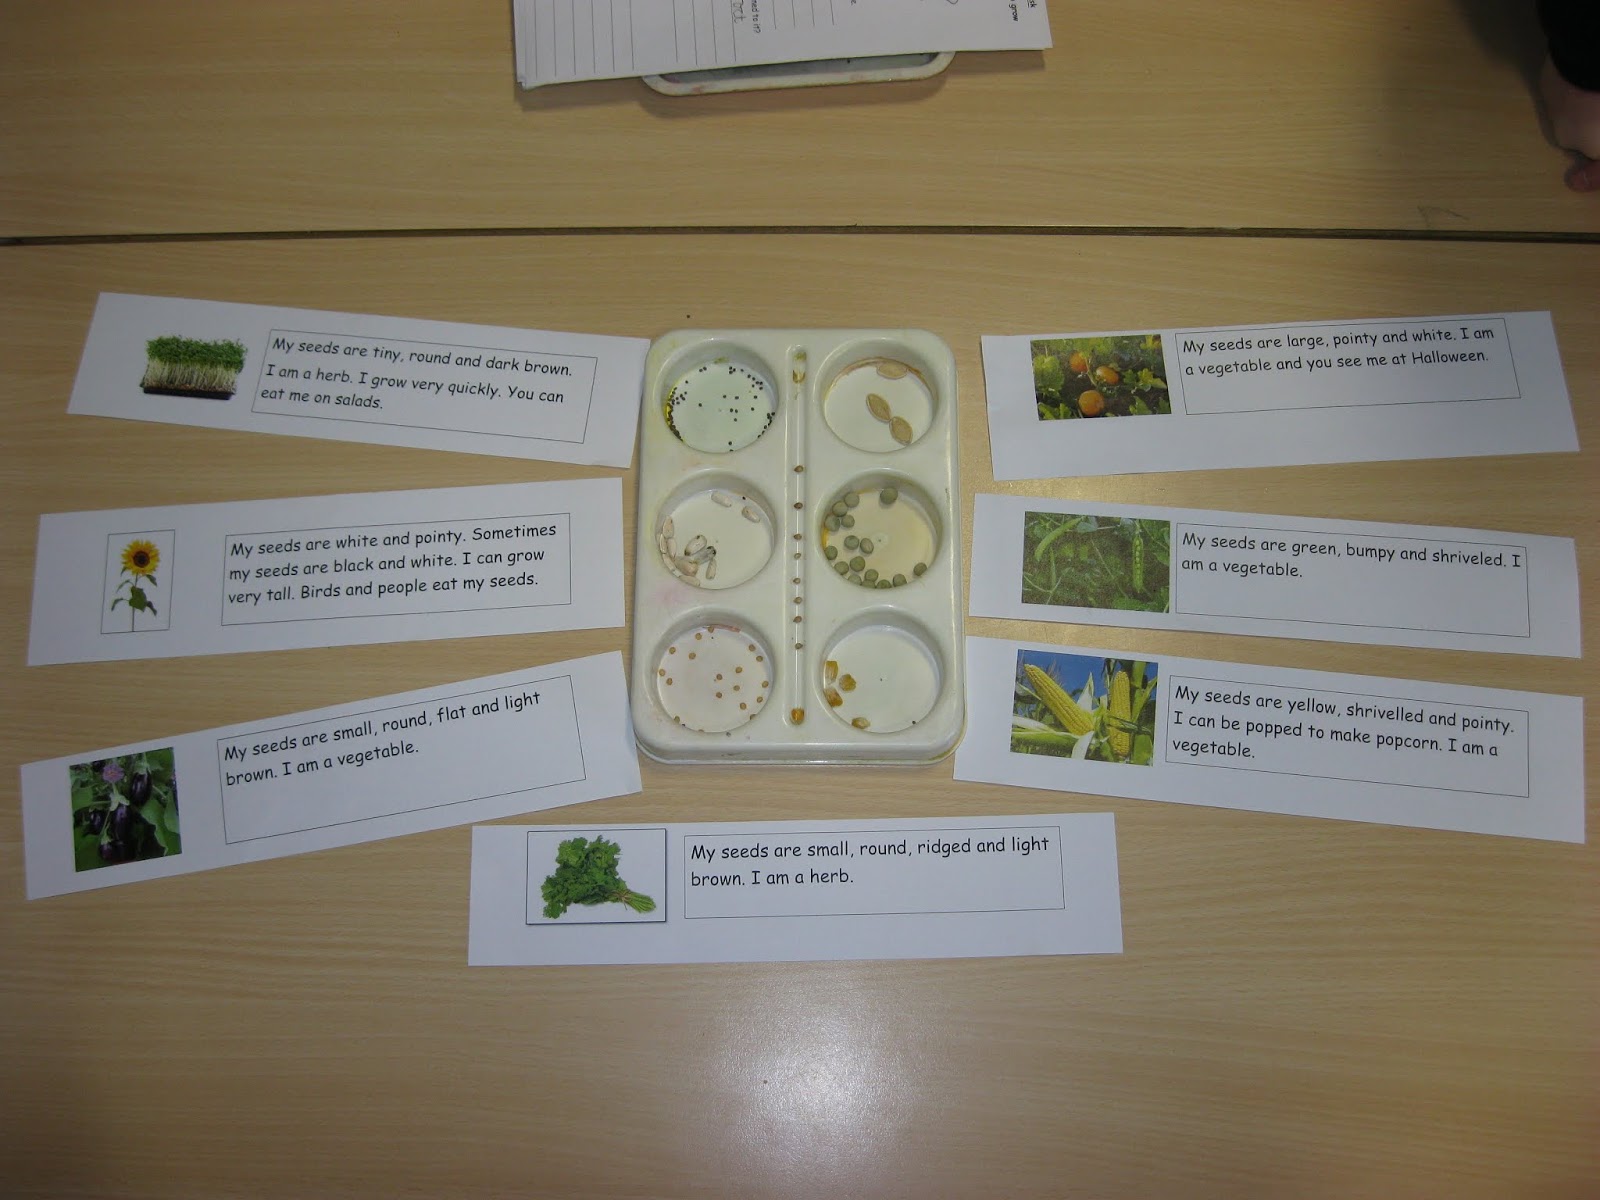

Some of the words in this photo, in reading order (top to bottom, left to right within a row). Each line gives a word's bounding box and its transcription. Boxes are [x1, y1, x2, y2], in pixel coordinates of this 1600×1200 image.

[752, 14, 759, 22] to
[1008, 4, 1019, 22] grow
[753, 23, 761, 34] it?
[272, 338, 294, 354] My
[298, 341, 339, 354] seeds
[343, 347, 368, 357] are
[373, 347, 404, 363] tiny,
[409, 352, 451, 364] round
[455, 355, 482, 367] and
[486, 356, 519, 371] dark
[525, 359, 571, 376] brown.
[1183, 340, 1204, 356] My
[1210, 337, 1252, 351] seeds
[1257, 339, 1282, 348] are
[1287, 334, 1328, 350] large,
[1333, 332, 1377, 348] pointy
[1383, 330, 1407, 343] and
[1412, 329, 1456, 342] white.
[1460, 328, 1469, 339] I
[1474, 330, 1494, 339] am
[1186, 367, 1194, 375] a
[1198, 358, 1271, 377] vegetable
[1277, 356, 1302, 370] and
[1306, 359, 1332, 372] you
[1337, 358, 1362, 367] see
[1367, 357, 1388, 366] me
[1392, 353, 1406, 364] at
[1412, 350, 1488, 364] Halloween.
[266, 364, 275, 376] I
[279, 369, 298, 378] am
[303, 371, 311, 379] a
[316, 368, 352, 383] herb.
[358, 372, 368, 384] I
[371, 377, 407, 389] grow
[412, 380, 444, 395] very
[448, 382, 501, 400] quickly.
[508, 386, 534, 400] You
[539, 392, 563, 403] can
[261, 389, 285, 399] eat
[289, 392, 310, 402] me
[314, 394, 330, 404] on
[335, 394, 382, 409] salads.
[231, 543, 253, 559] My
[258, 539, 301, 554] seeds
[306, 540, 331, 550] are
[336, 535, 378, 549] white
[383, 531, 410, 546] and
[416, 530, 466, 548] pointy.
[472, 525, 556, 540] Sometimes
[1183, 532, 1206, 550] My
[1211, 536, 1255, 550] seeds
[1261, 541, 1286, 551] are
[1292, 543, 1340, 557] green,
[1347, 542, 1395, 562] bumpy
[1400, 548, 1426, 561] and
[1432, 549, 1506, 567] shriveled.
[1511, 554, 1522, 568] I
[230, 569, 250, 583] my
[255, 563, 298, 578] seeds
[303, 564, 328, 575] are
[334, 557, 374, 572] black
[379, 555, 405, 570] and
[411, 554, 456, 568] white.
[463, 552, 471, 565] I
[477, 554, 502, 564] can
[508, 551, 544, 566] grow
[1182, 560, 1203, 570] am
[1209, 562, 1217, 571] a
[1223, 562, 1302, 577] vegetable.
[229, 593, 261, 606] very
[267, 586, 294, 601] tall.
[301, 583, 340, 599] Birds
[346, 581, 372, 596] and
[378, 578, 427, 598] people
[433, 578, 458, 591] eat
[464, 579, 485, 592] my
[490, 572, 538, 587] seeds.
[1175, 685, 1199, 704] My
[1204, 691, 1250, 706] seeds
[1256, 697, 1282, 709] are
[1288, 697, 1340, 717] yellow,
[1346, 702, 1423, 723] shrivelled
[1429, 712, 1456, 726] and
[1462, 716, 1514, 736] pointy.
[225, 746, 247, 762] My
[252, 736, 297, 755] seeds
[302, 733, 328, 746] are
[333, 720, 377, 741] small,
[383, 711, 432, 732] round,
[437, 706, 466, 723] flat
[472, 697, 499, 715] and
[505, 692, 540, 712] light
[1174, 711, 1183, 724] I
[1189, 716, 1215, 728] can
[1222, 715, 1240, 730] be
[1246, 721, 1302, 738] popped
[1308, 725, 1324, 739] to
[1331, 728, 1370, 743] make
[1377, 734, 1442, 751] popcorn.
[1448, 738, 1457, 752] I
[1462, 744, 1484, 755] am
[1489, 746, 1498, 756] a
[226, 769, 277, 786] brown.
[282, 762, 292, 775] I
[297, 761, 319, 773] am
[324, 758, 332, 768] a
[337, 740, 418, 767] vegetable.
[1173, 740, 1254, 758] vegetable.
[691, 845, 715, 863] My
[721, 843, 768, 859] seeds
[774, 846, 802, 857] are
[808, 840, 853, 858] small,
[860, 839, 911, 856] round,
[918, 838, 971, 858] ridged
[977, 837, 1005, 852] and
[1012, 836, 1049, 856] light
[692, 871, 745, 886] brown.
[752, 871, 760, 884] I
[767, 873, 789, 885] am
[795, 873, 804, 884] a
[811, 868, 853, 883] herb.
